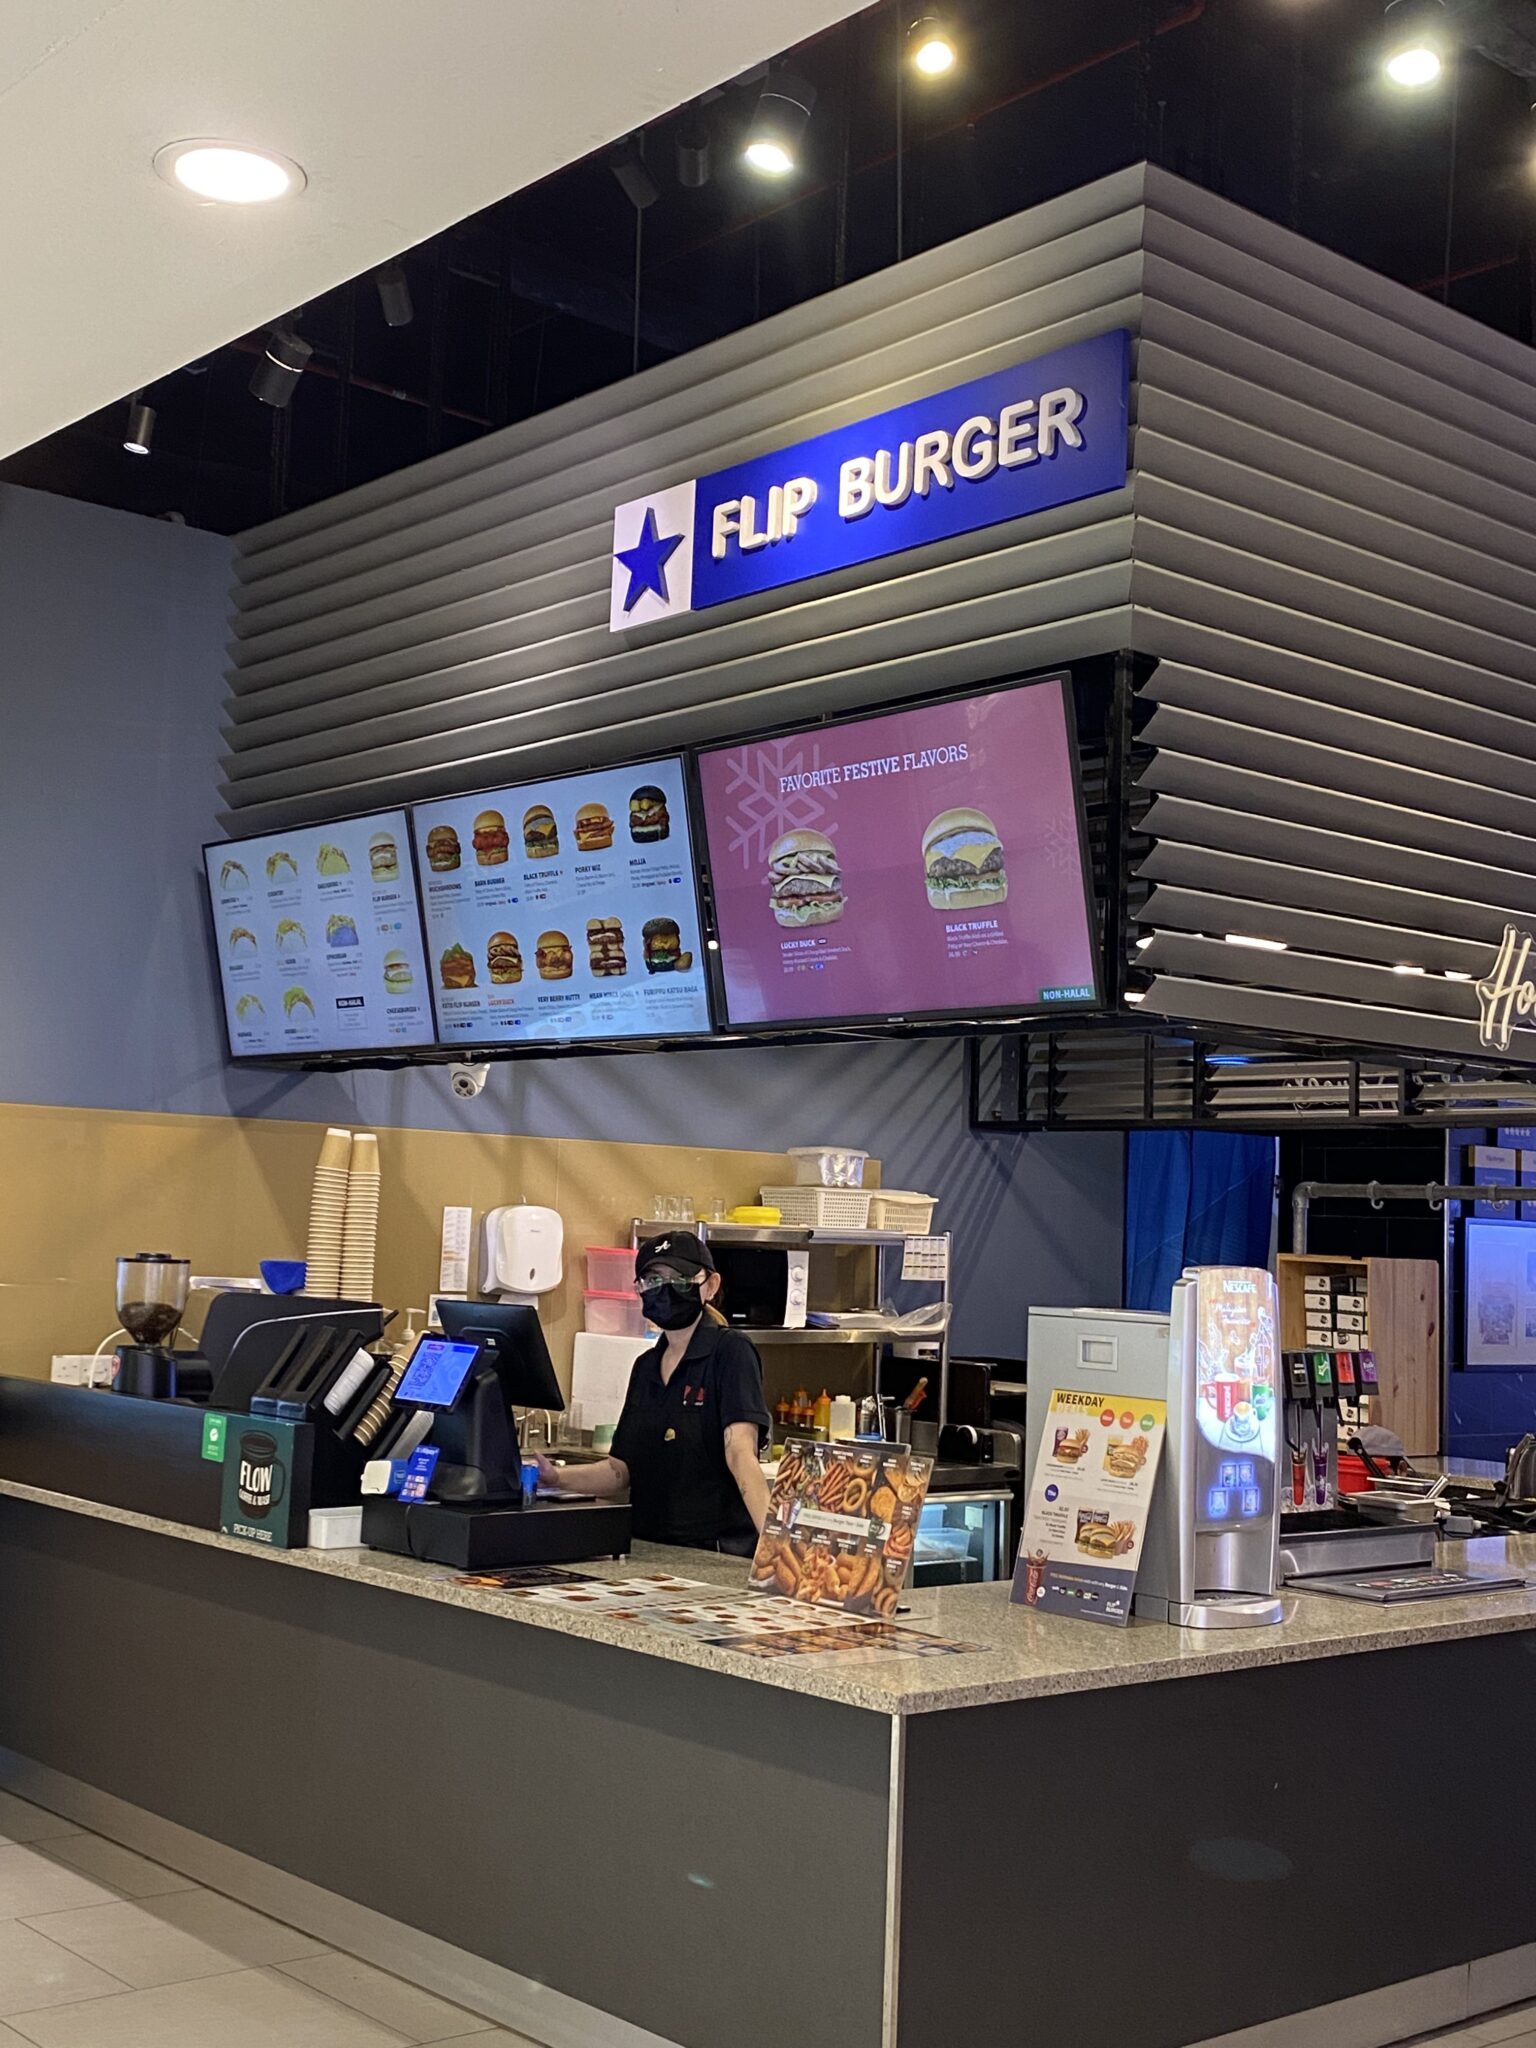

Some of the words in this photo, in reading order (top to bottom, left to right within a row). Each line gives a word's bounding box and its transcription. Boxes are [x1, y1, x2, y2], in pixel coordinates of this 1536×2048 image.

[711, 476, 818, 560] FLIP
[838, 386, 1084, 519] BURGER
[779, 767, 842, 792] FAVORITE
[842, 756, 900, 781] FESTIVE
[902, 743, 968, 771] FLAVORS
[945, 923, 968, 933] BLACK
[968, 920, 998, 930] TRUFFLE
[780, 940, 799, 950] LUCKY
[799, 939, 816, 948] DUCK
[1043, 988, 1090, 1000] NON-HALAL
[1481, 929, 1536, 1044] Ho
[1056, 1392, 1105, 1408] WEEKDAY
[239, 1460, 273, 1493] FLOW
